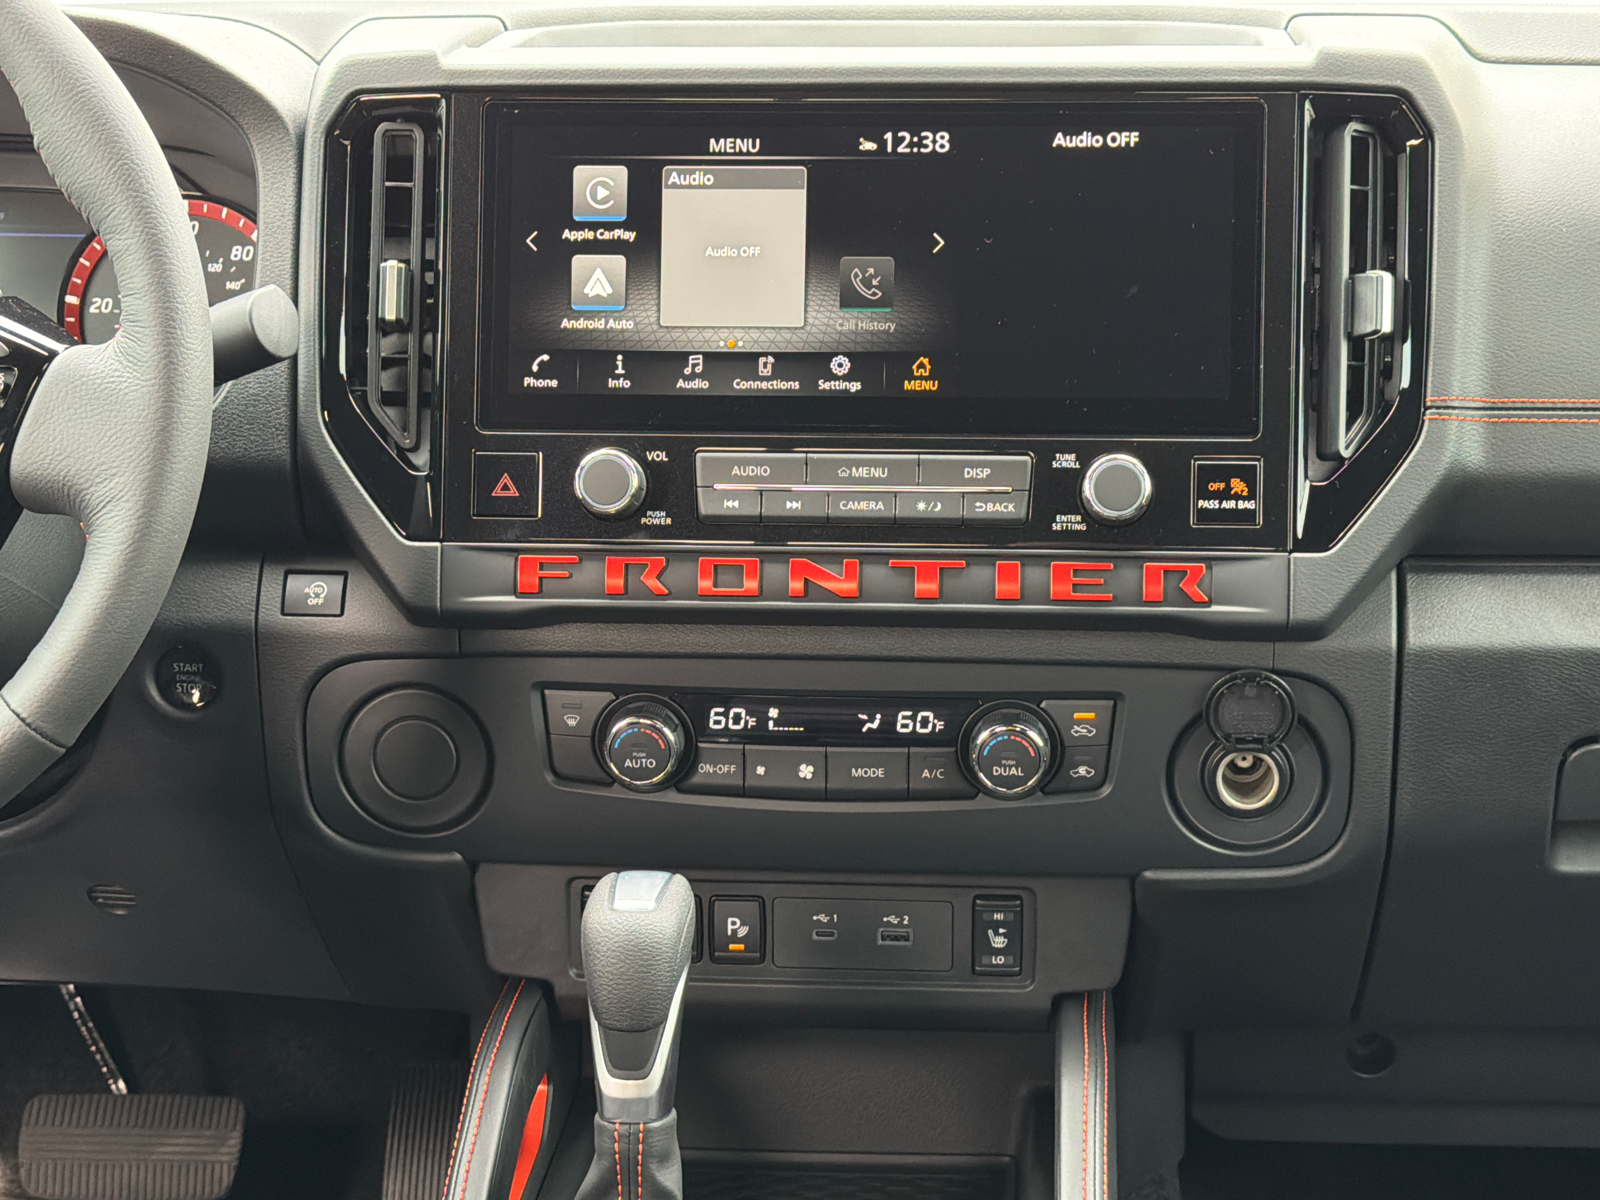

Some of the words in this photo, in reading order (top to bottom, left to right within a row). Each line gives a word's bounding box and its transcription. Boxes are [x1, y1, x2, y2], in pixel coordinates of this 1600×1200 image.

[884, 131, 950, 153] 12:38
[1052, 131, 1103, 147] Audio
[1106, 131, 1140, 148] OFF
[709, 138, 760, 153] MENU
[668, 171, 714, 186] Audio
[562, 229, 594, 241] Apple
[596, 229, 636, 242] CarPlay
[230, 245, 254, 261] 80
[705, 246, 738, 257] Audio
[740, 247, 761, 257] OFF
[207, 263, 223, 273] 120
[225, 281, 241, 290] 140
[89, 298, 113, 313] 20
[560, 318, 604, 329] Android
[606, 319, 634, 329] Auto
[836, 320, 856, 331] Call
[857, 320, 896, 333] History
[523, 377, 558, 388] Phone
[608, 378, 631, 388] Info
[676, 378, 709, 389] Audio
[733, 379, 800, 390] Connections
[818, 379, 862, 392] Settings
[904, 380, 939, 391] MENU
[646, 451, 668, 461] VOL
[1055, 453, 1077, 461] TUNE
[731, 466, 770, 477] AUDIO
[852, 467, 888, 478] MENU
[964, 467, 991, 478] DISP
[1208, 482, 1226, 491] OFF
[839, 500, 884, 511] CAMERA
[986, 502, 1015, 512] BACK
[1198, 500, 1219, 509] PASS
[1220, 500, 1236, 509] AIR
[1237, 500, 1256, 509] BAG
[646, 510, 666, 518] PUSH
[1056, 514, 1082, 522] ENTER
[641, 517, 672, 525] POWER
[1052, 523, 1087, 531] SETTING
[517, 555, 1209, 602] FRONTIER
[173, 662, 204, 672] START
[176, 683, 202, 693] STOP
[624, 758, 656, 769] AUTO
[698, 763, 737, 774] ON-OFF
[851, 767, 885, 778] MODE
[921, 768, 945, 779] A/C
[992, 766, 1024, 776] DUAL
[833, 914, 838, 923] 1
[903, 915, 909, 924] 2
[993, 912, 1004, 920] HI
[727, 917, 741, 936] P
[992, 955, 1005, 964] LO
